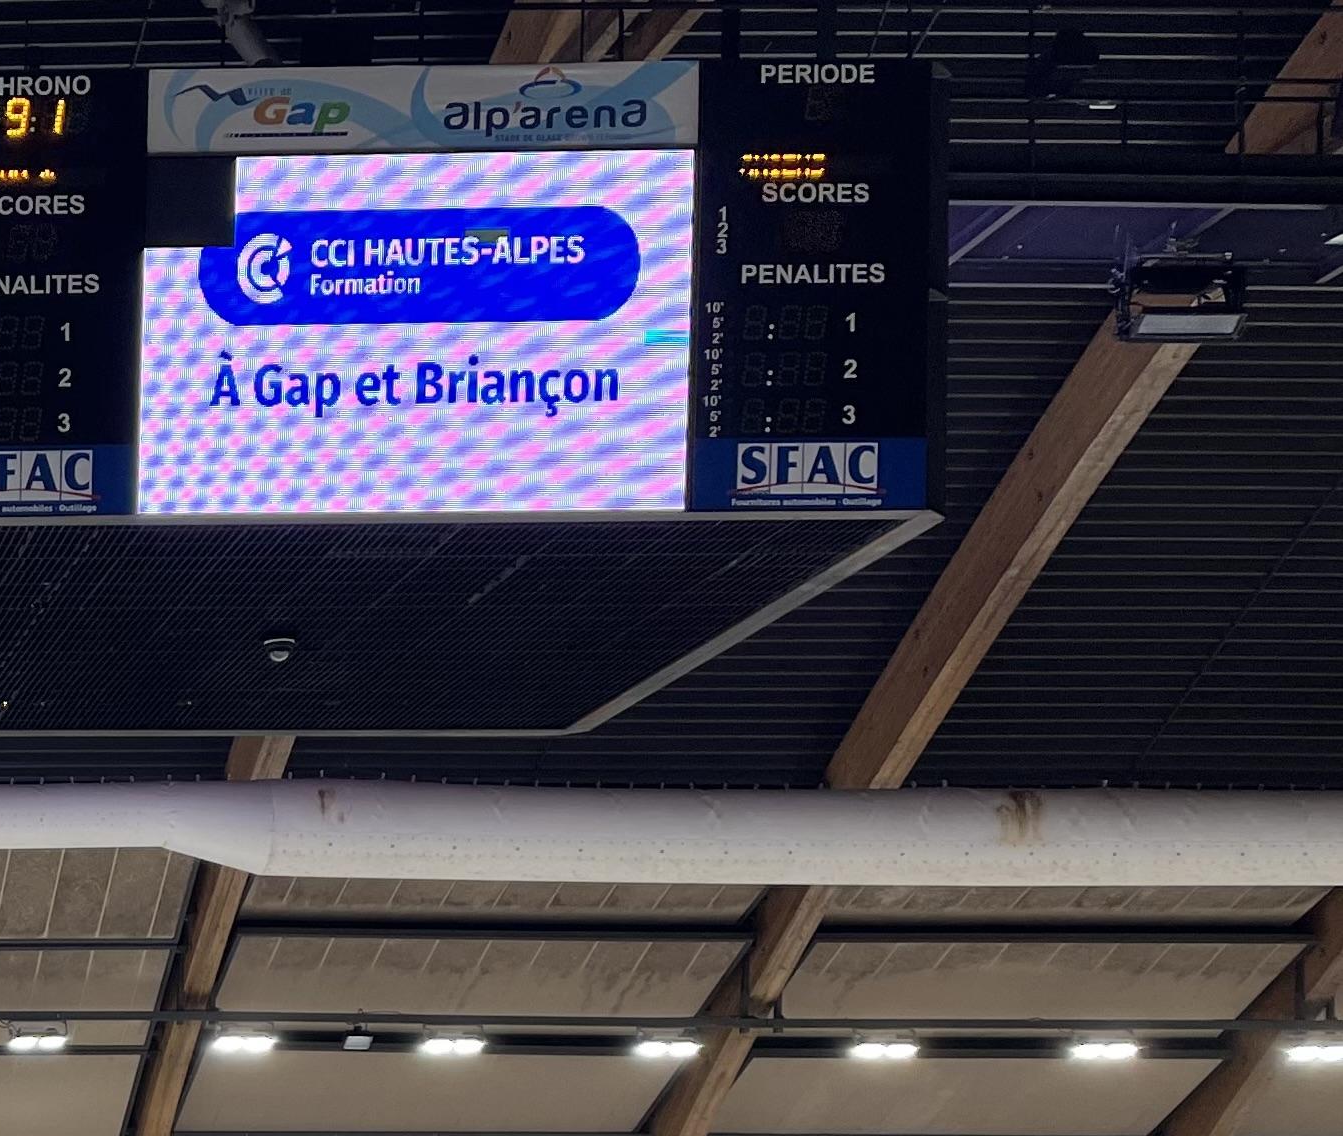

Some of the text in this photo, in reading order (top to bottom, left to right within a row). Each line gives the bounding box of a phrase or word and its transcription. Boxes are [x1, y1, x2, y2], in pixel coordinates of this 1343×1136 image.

[760, 63, 875, 84] PERIODE
[253, 97, 351, 134] Gap
[444, 99, 647, 137] alp'arena
[762, 183, 870, 203] SCORES
[718, 206, 727, 222] 1
[717, 222, 728, 238] 2
[311, 234, 584, 268] CCI HAUTES-ALPES
[716, 239, 727, 254] 3
[741, 263, 885, 284] PENALITES
[310, 273, 420, 296] Formation
[60, 322, 71, 342] 1
[845, 312, 856, 332] 1
[58, 368, 72, 388] 2
[843, 359, 858, 379] 2
[212, 351, 619, 418] À Gap et Briançon
[57, 412, 71, 433] 3
[842, 405, 856, 424] 3
[741, 445, 875, 486] SFAC
